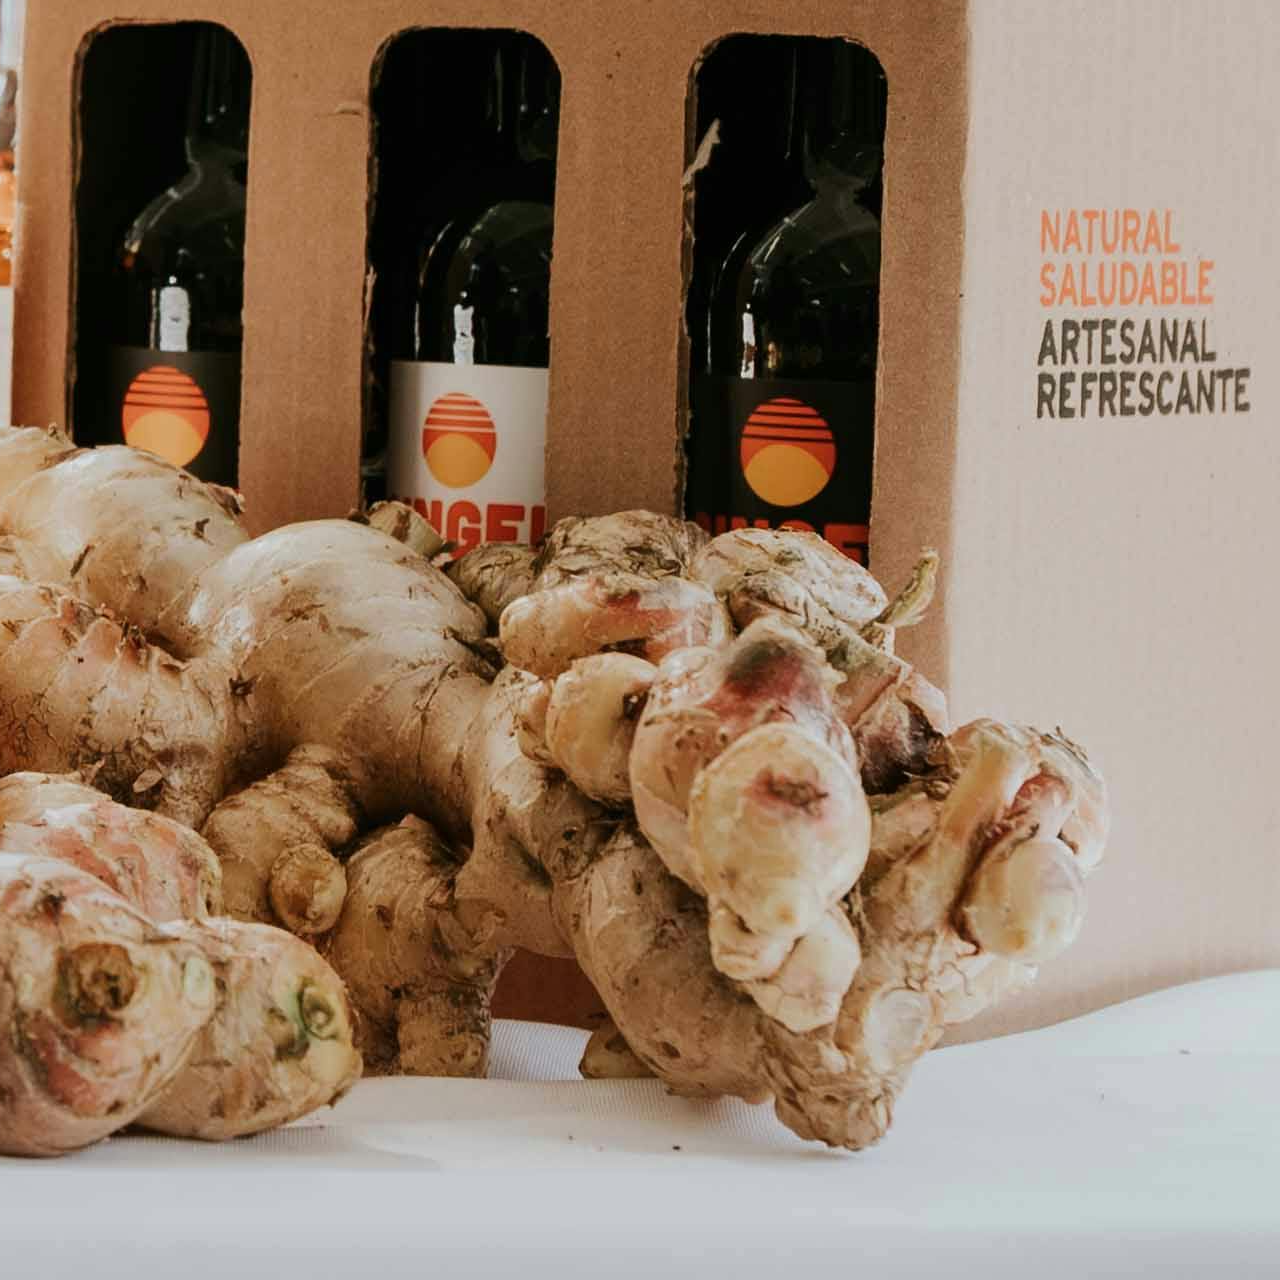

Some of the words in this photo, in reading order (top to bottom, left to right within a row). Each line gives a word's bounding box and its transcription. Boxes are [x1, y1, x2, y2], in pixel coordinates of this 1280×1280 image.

[1040, 208, 1181, 255] NATURAL
[1039, 260, 1215, 308] SALUDABLE
[1038, 318, 1216, 366] ARTESANAL
[1037, 368, 1250, 420] REFRESCANTE
